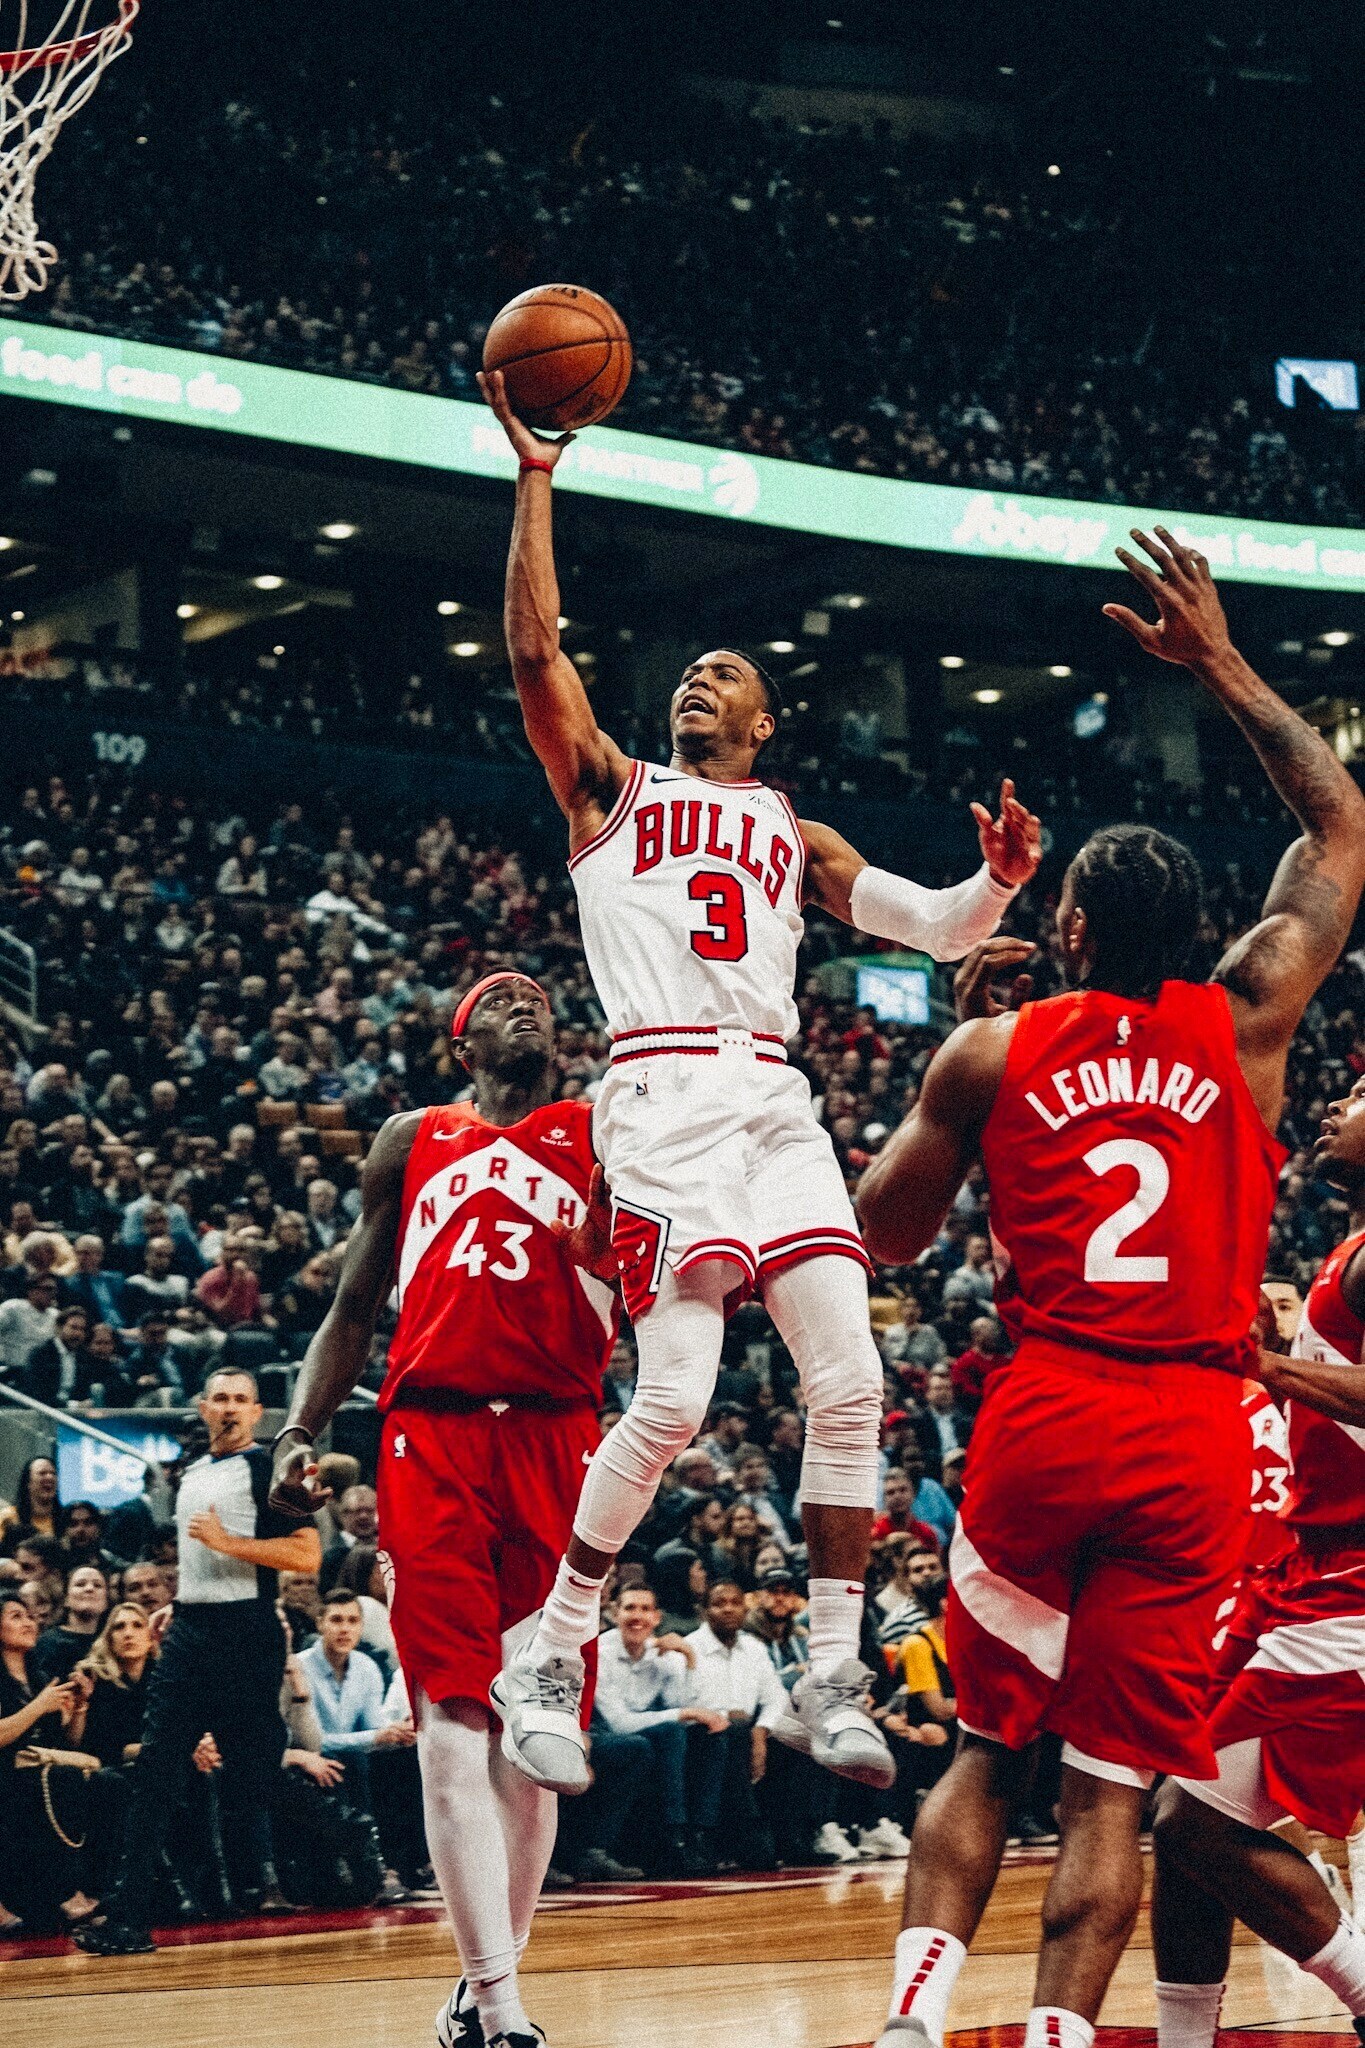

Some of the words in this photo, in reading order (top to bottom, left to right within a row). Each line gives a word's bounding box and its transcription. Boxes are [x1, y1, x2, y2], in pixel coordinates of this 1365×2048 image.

[92, 731, 147, 765] 109
[632, 800, 793, 909] BULLS
[687, 870, 749, 963] 3
[1024, 1057, 1221, 1131] LEONARD
[419, 1156, 576, 1229] NORTH
[1082, 1138, 1170, 1283] 2
[445, 1216, 533, 1281] 43
